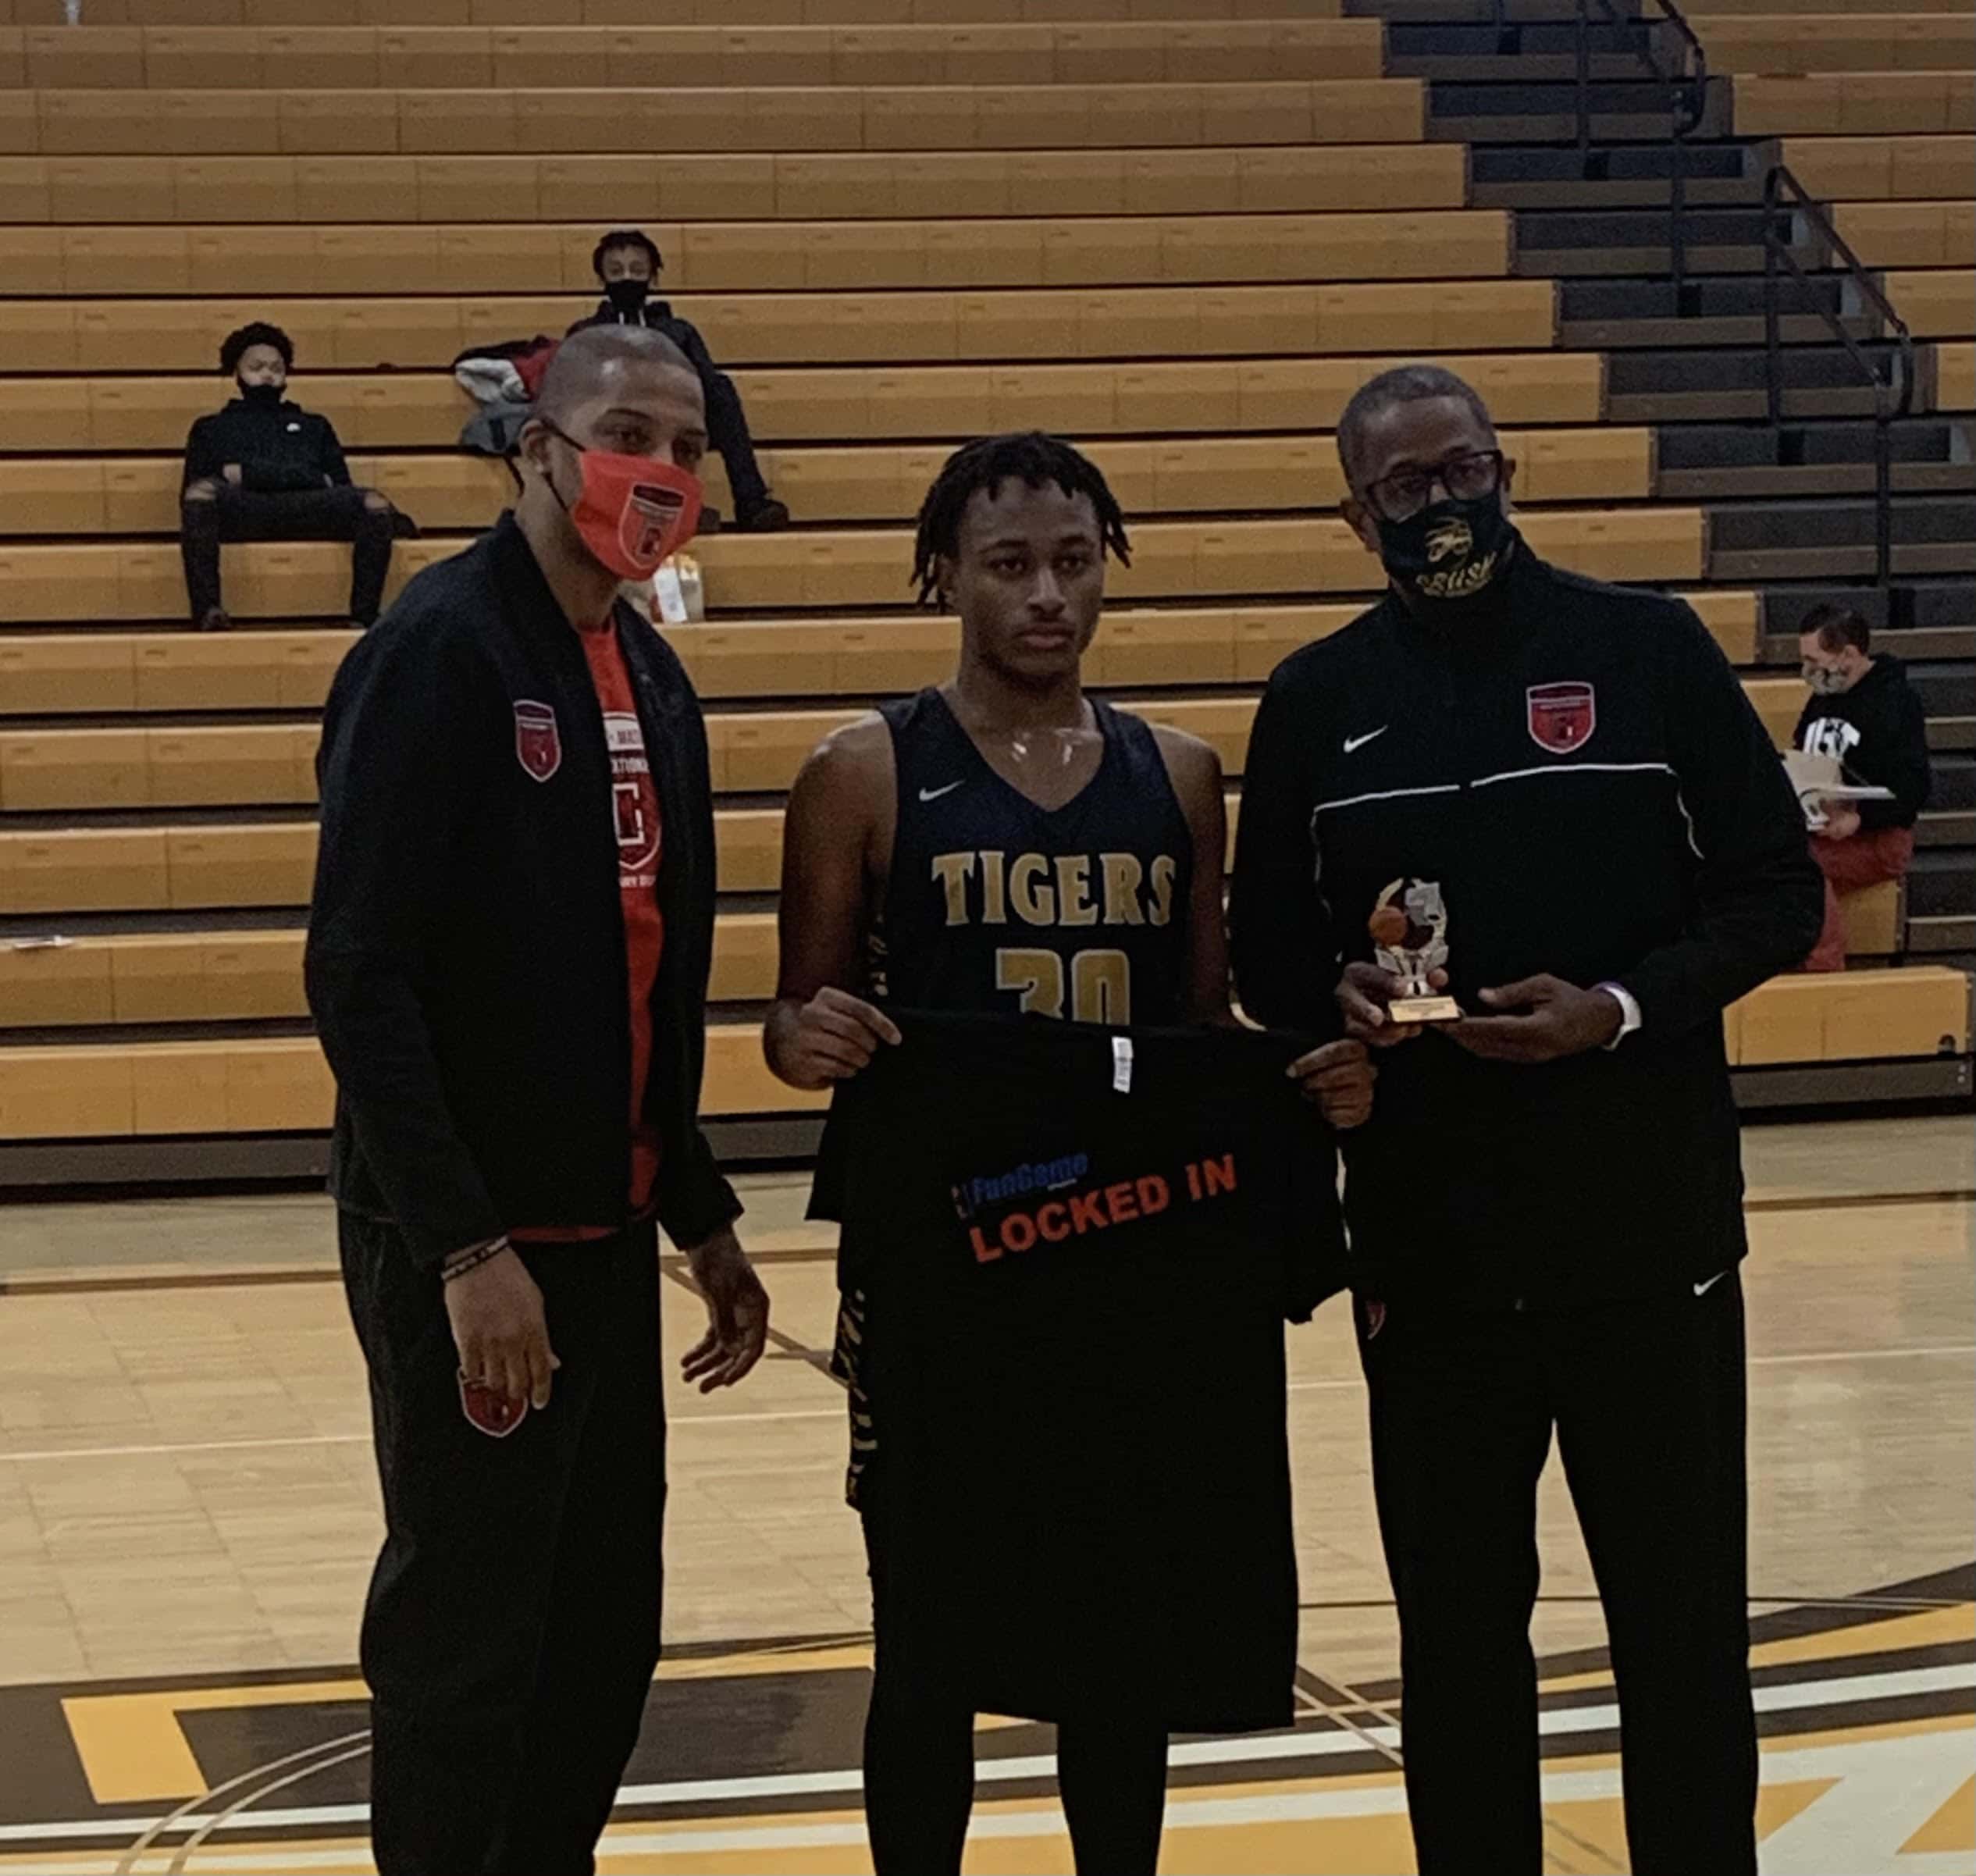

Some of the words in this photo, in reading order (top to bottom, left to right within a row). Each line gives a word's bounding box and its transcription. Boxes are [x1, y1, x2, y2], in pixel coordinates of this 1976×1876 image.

[931, 850, 1176, 926] TIGERS
[969, 1173, 1170, 1263] LOCKED
[1185, 1148, 1237, 1202] IN
